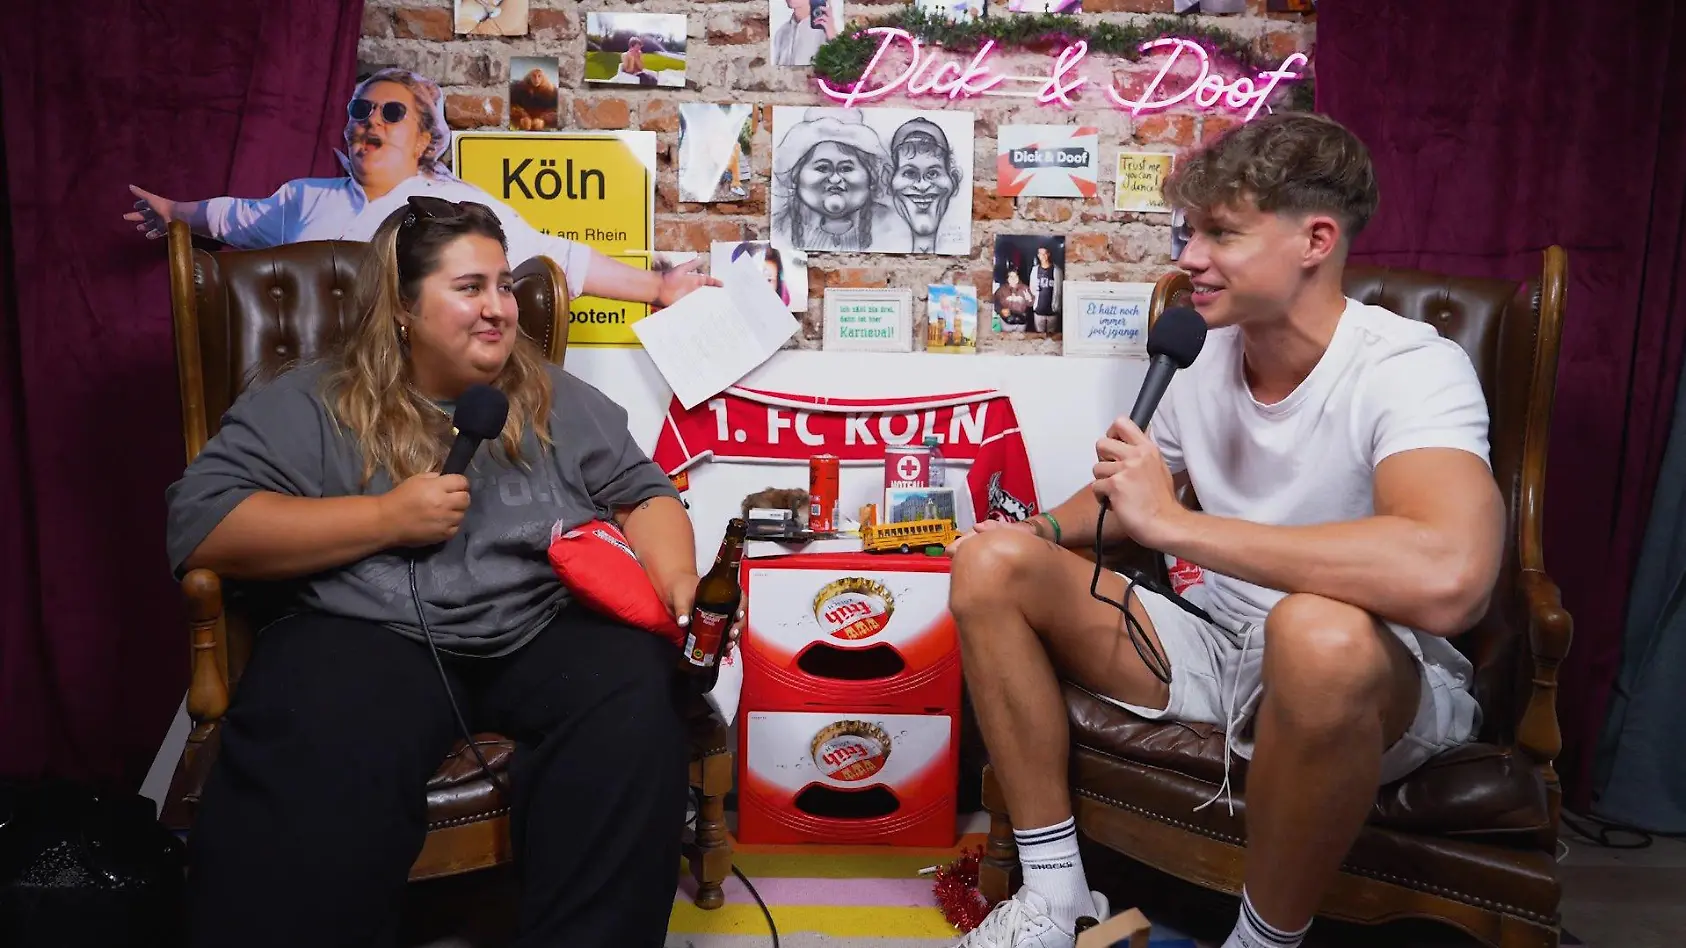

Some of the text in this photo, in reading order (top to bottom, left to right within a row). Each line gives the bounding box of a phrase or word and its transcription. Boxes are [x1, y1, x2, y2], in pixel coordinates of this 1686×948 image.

[818, 26, 1309, 123] Dick & Doof
[1013, 150, 1041, 163] Dick
[1056, 151, 1088, 163] Doof
[1121, 156, 1147, 170] Trust
[502, 158, 606, 200] Köln
[557, 230, 579, 241] am
[585, 228, 627, 241] Rhein
[1119, 304, 1140, 316] noch
[840, 326, 895, 338] Karneval!
[708, 397, 747, 444] 1.
[767, 404, 825, 446] FC
